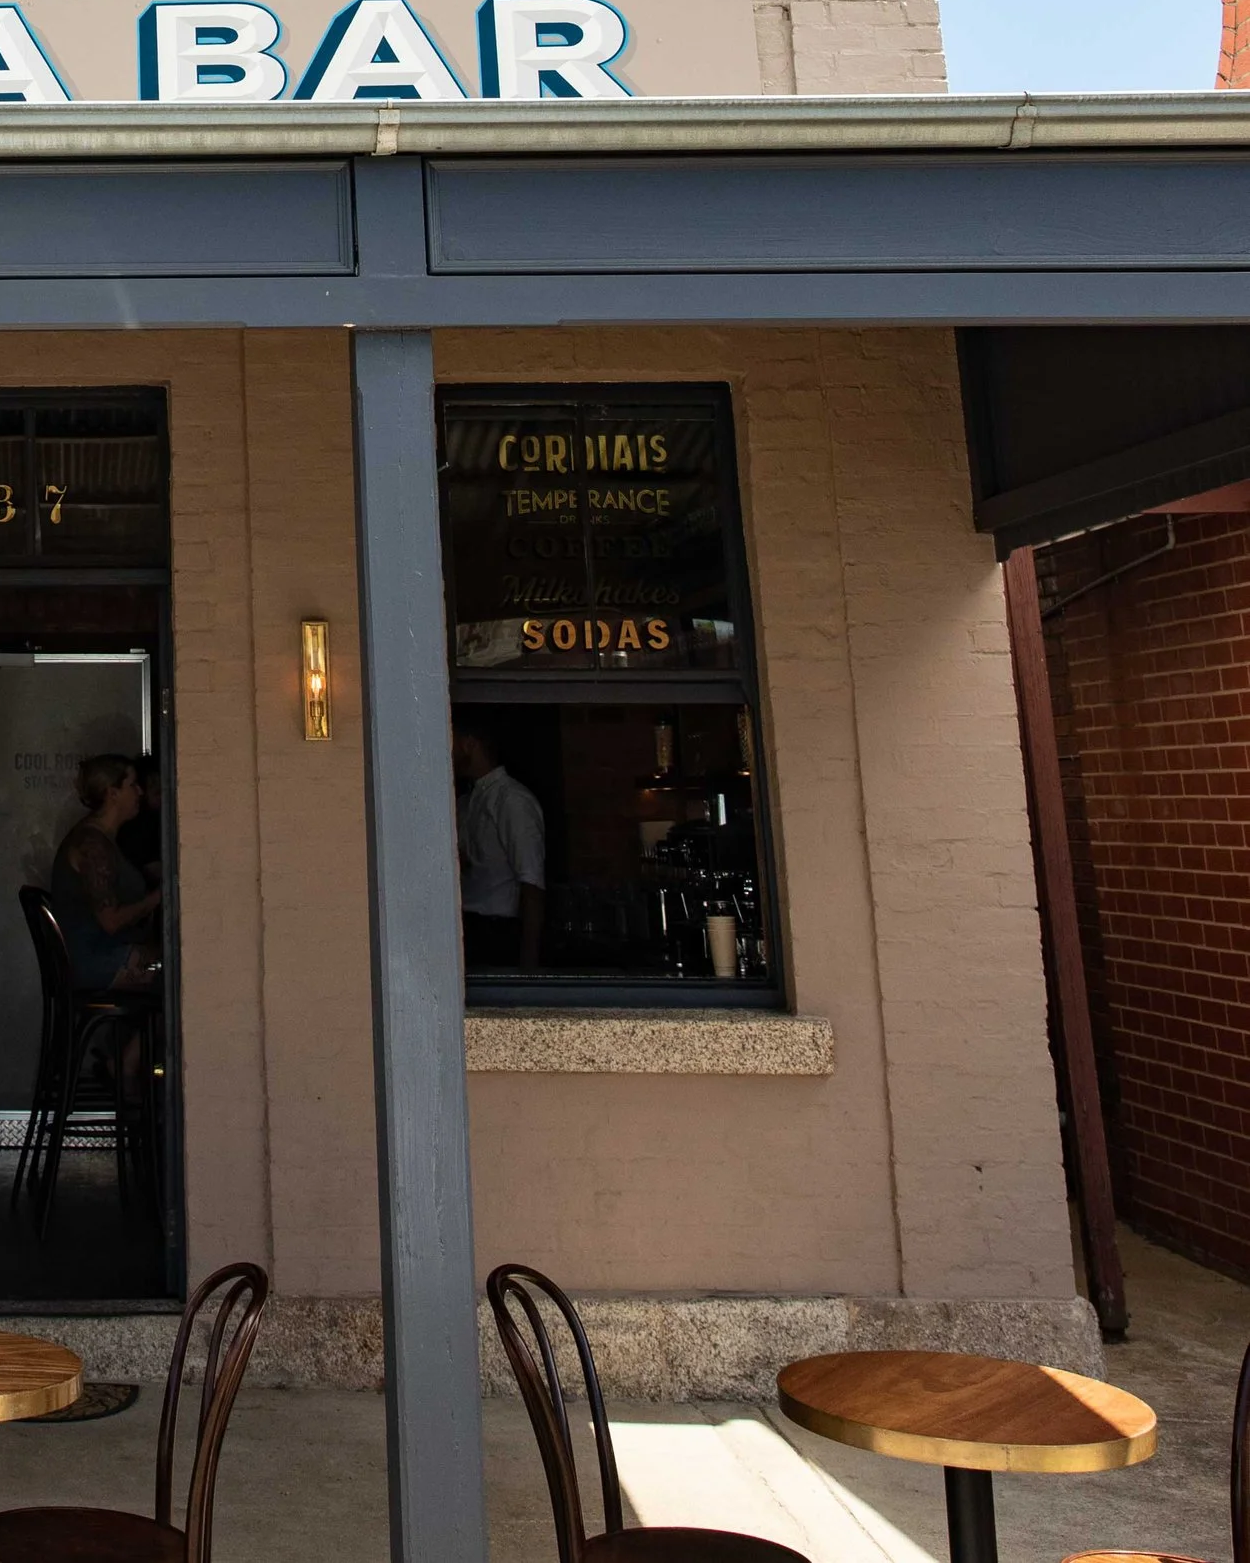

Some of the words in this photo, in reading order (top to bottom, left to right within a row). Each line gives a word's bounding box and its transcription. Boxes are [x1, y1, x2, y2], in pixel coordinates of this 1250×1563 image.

[502, 488, 671, 518] TEMPERANCE
[559, 514, 611, 525] DRNKS
[507, 536, 674, 560] COFFEE
[522, 618, 671, 652] SODAS
